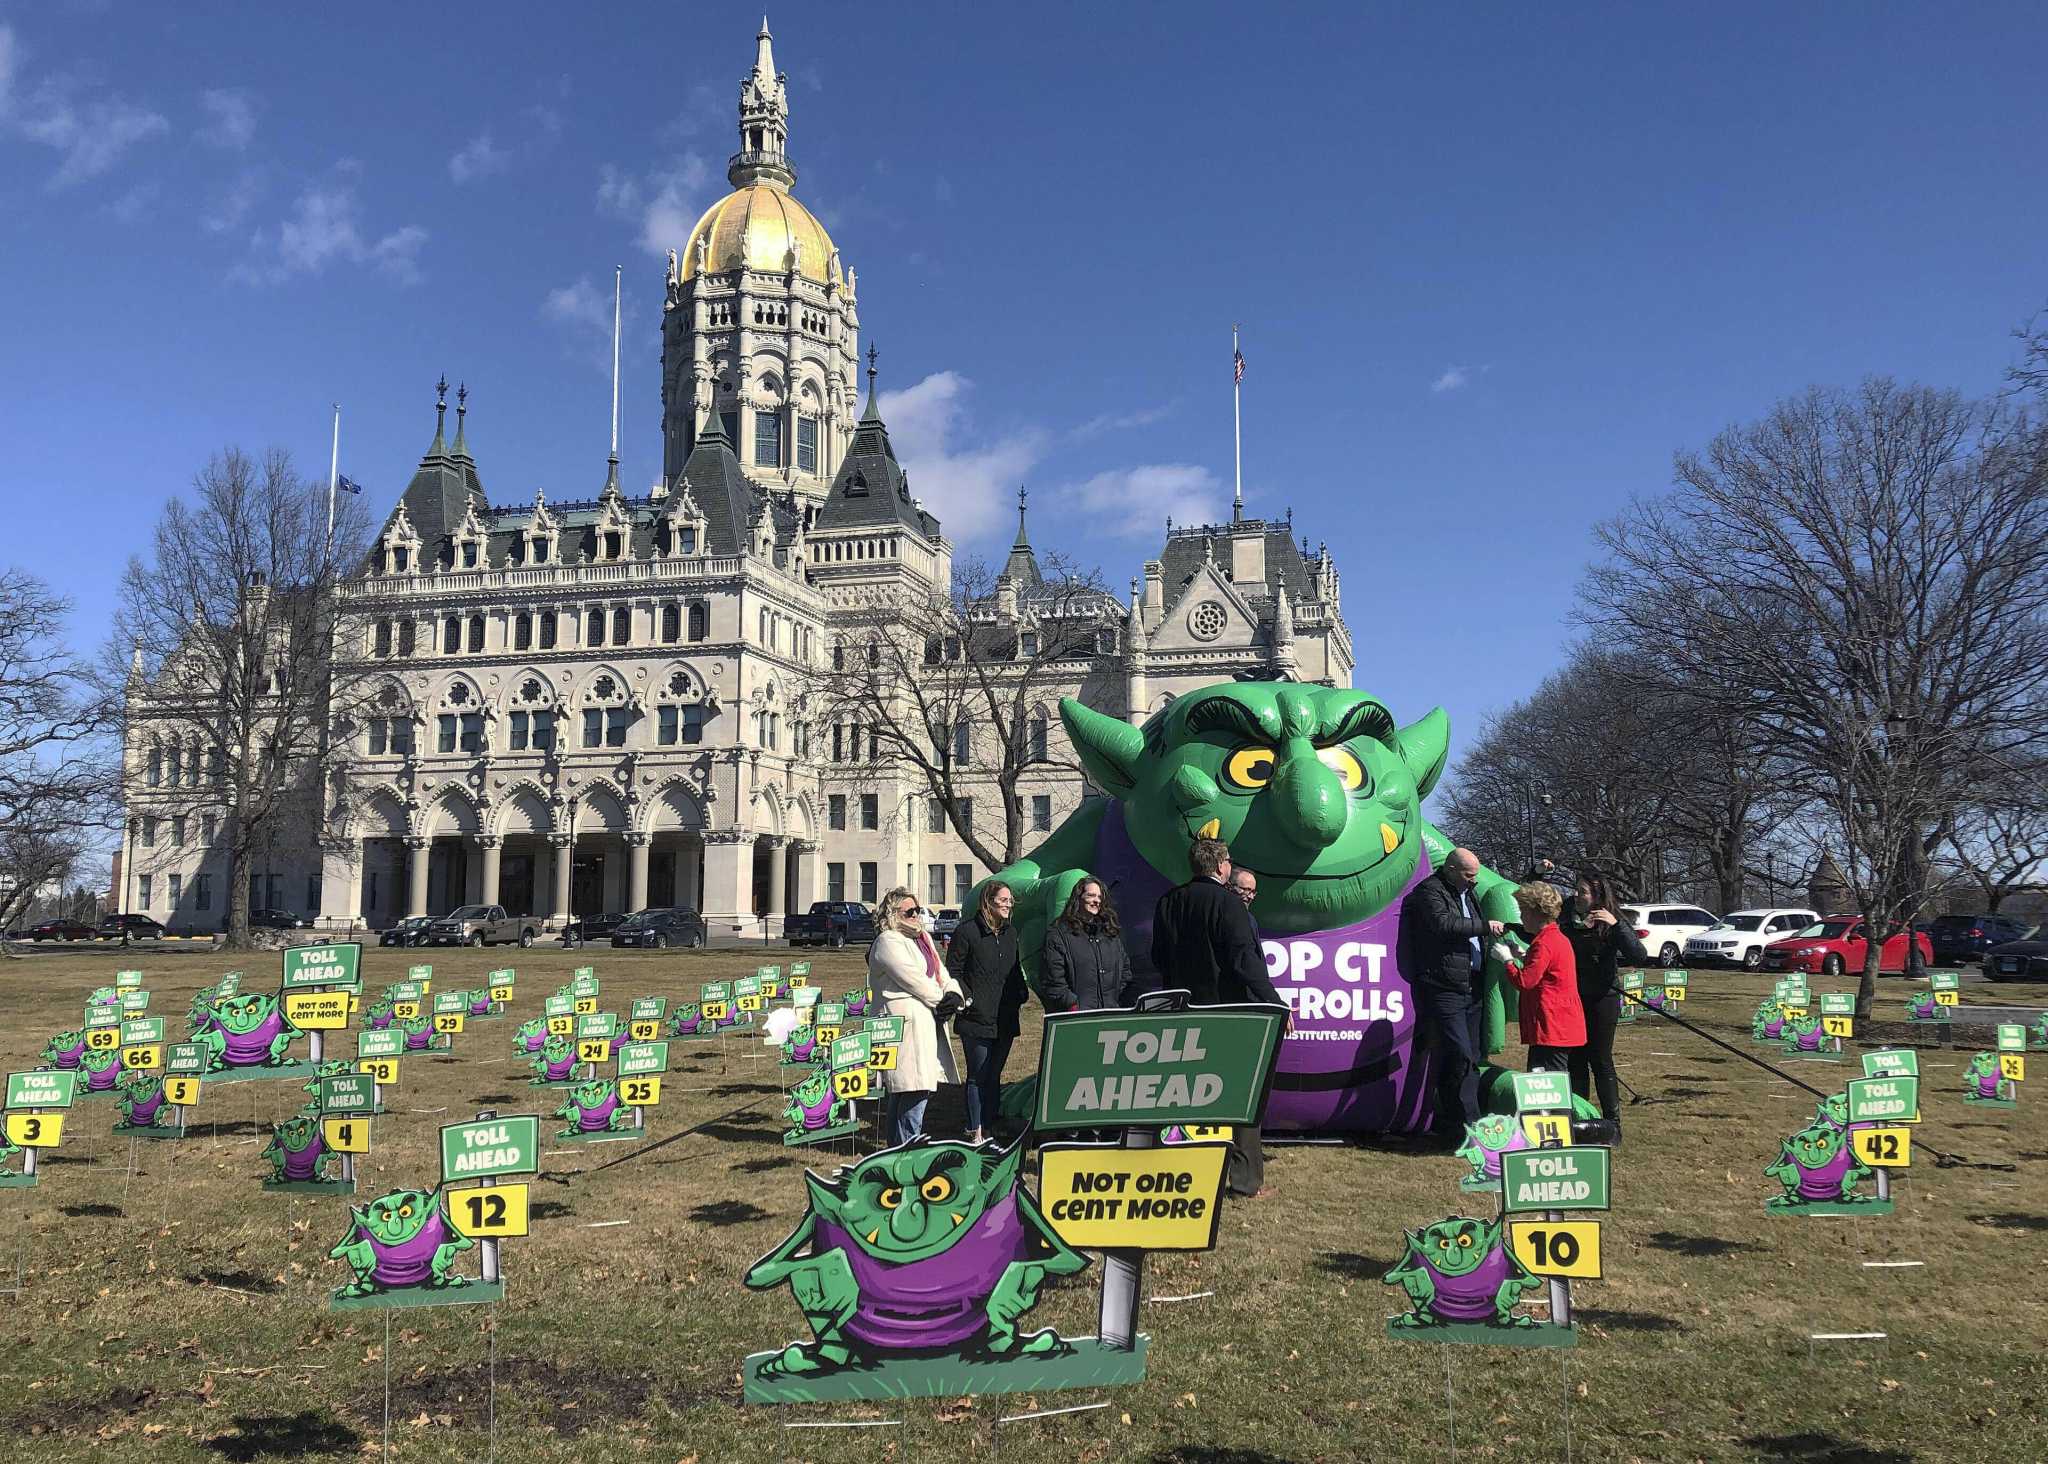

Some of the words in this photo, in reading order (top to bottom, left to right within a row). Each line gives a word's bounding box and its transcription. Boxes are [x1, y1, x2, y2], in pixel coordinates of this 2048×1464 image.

[300, 950, 338, 964] TOLL
[1334, 942, 1387, 982] CT
[292, 966, 344, 982] AHEAD
[496, 990, 507, 998] 52
[762, 986, 772, 994] 37
[1669, 990, 1681, 998] 79
[578, 1002, 591, 1012] 57
[742, 999, 754, 1008] 51
[1274, 987, 1404, 1022] TROLLS
[93, 1008, 112, 1016] TOLL
[398, 1006, 413, 1015] 59
[707, 1007, 721, 1016] 54
[130, 1022, 152, 1030] TOLL
[440, 1018, 457, 1029] 29
[553, 1020, 566, 1031] 53
[588, 1016, 605, 1024] TOLL
[872, 1021, 893, 1030] TOLL
[636, 1025, 653, 1037] 49
[1830, 1021, 1844, 1032] 71
[92, 1034, 112, 1046] 69
[125, 1031, 156, 1041] AHEAD
[369, 1032, 391, 1042] TOLL
[821, 1031, 833, 1042] 23
[364, 1042, 396, 1053] AHEAD
[840, 1038, 860, 1050] TOLL
[1098, 1027, 1208, 1065] TOLL
[176, 1047, 196, 1058] TOLL
[584, 1045, 603, 1058] 24
[629, 1048, 654, 1058] TOLL
[837, 1050, 864, 1064] AHEAD
[128, 1051, 152, 1066] 66
[170, 1058, 199, 1069] AHEAD
[624, 1059, 658, 1070] AHEAD
[871, 1052, 890, 1065] 27
[23, 1076, 56, 1088] TOLL
[331, 1080, 358, 1091] TOLL
[840, 1076, 862, 1094] 20
[1526, 1078, 1554, 1090] TOLL
[14, 1089, 61, 1103] AHEAD
[174, 1082, 186, 1099] 5
[627, 1084, 650, 1100] 25
[1064, 1074, 1224, 1111] AHEAD
[1864, 1083, 1898, 1098] TOLL
[328, 1094, 364, 1107] AHEAD
[1524, 1092, 1561, 1105] AHEAD
[1858, 1101, 1906, 1116] AHEAD
[23, 1119, 40, 1140] 3
[338, 1124, 352, 1146] 4
[1534, 1122, 1560, 1140] 14
[463, 1126, 510, 1148] TOLL
[1866, 1135, 1898, 1160] 42
[455, 1148, 521, 1172] AHEAD
[1526, 1157, 1578, 1177] TOLL
[1517, 1181, 1590, 1202] AHEAD
[466, 1194, 505, 1228] 12
[1528, 1230, 1580, 1267] 10
